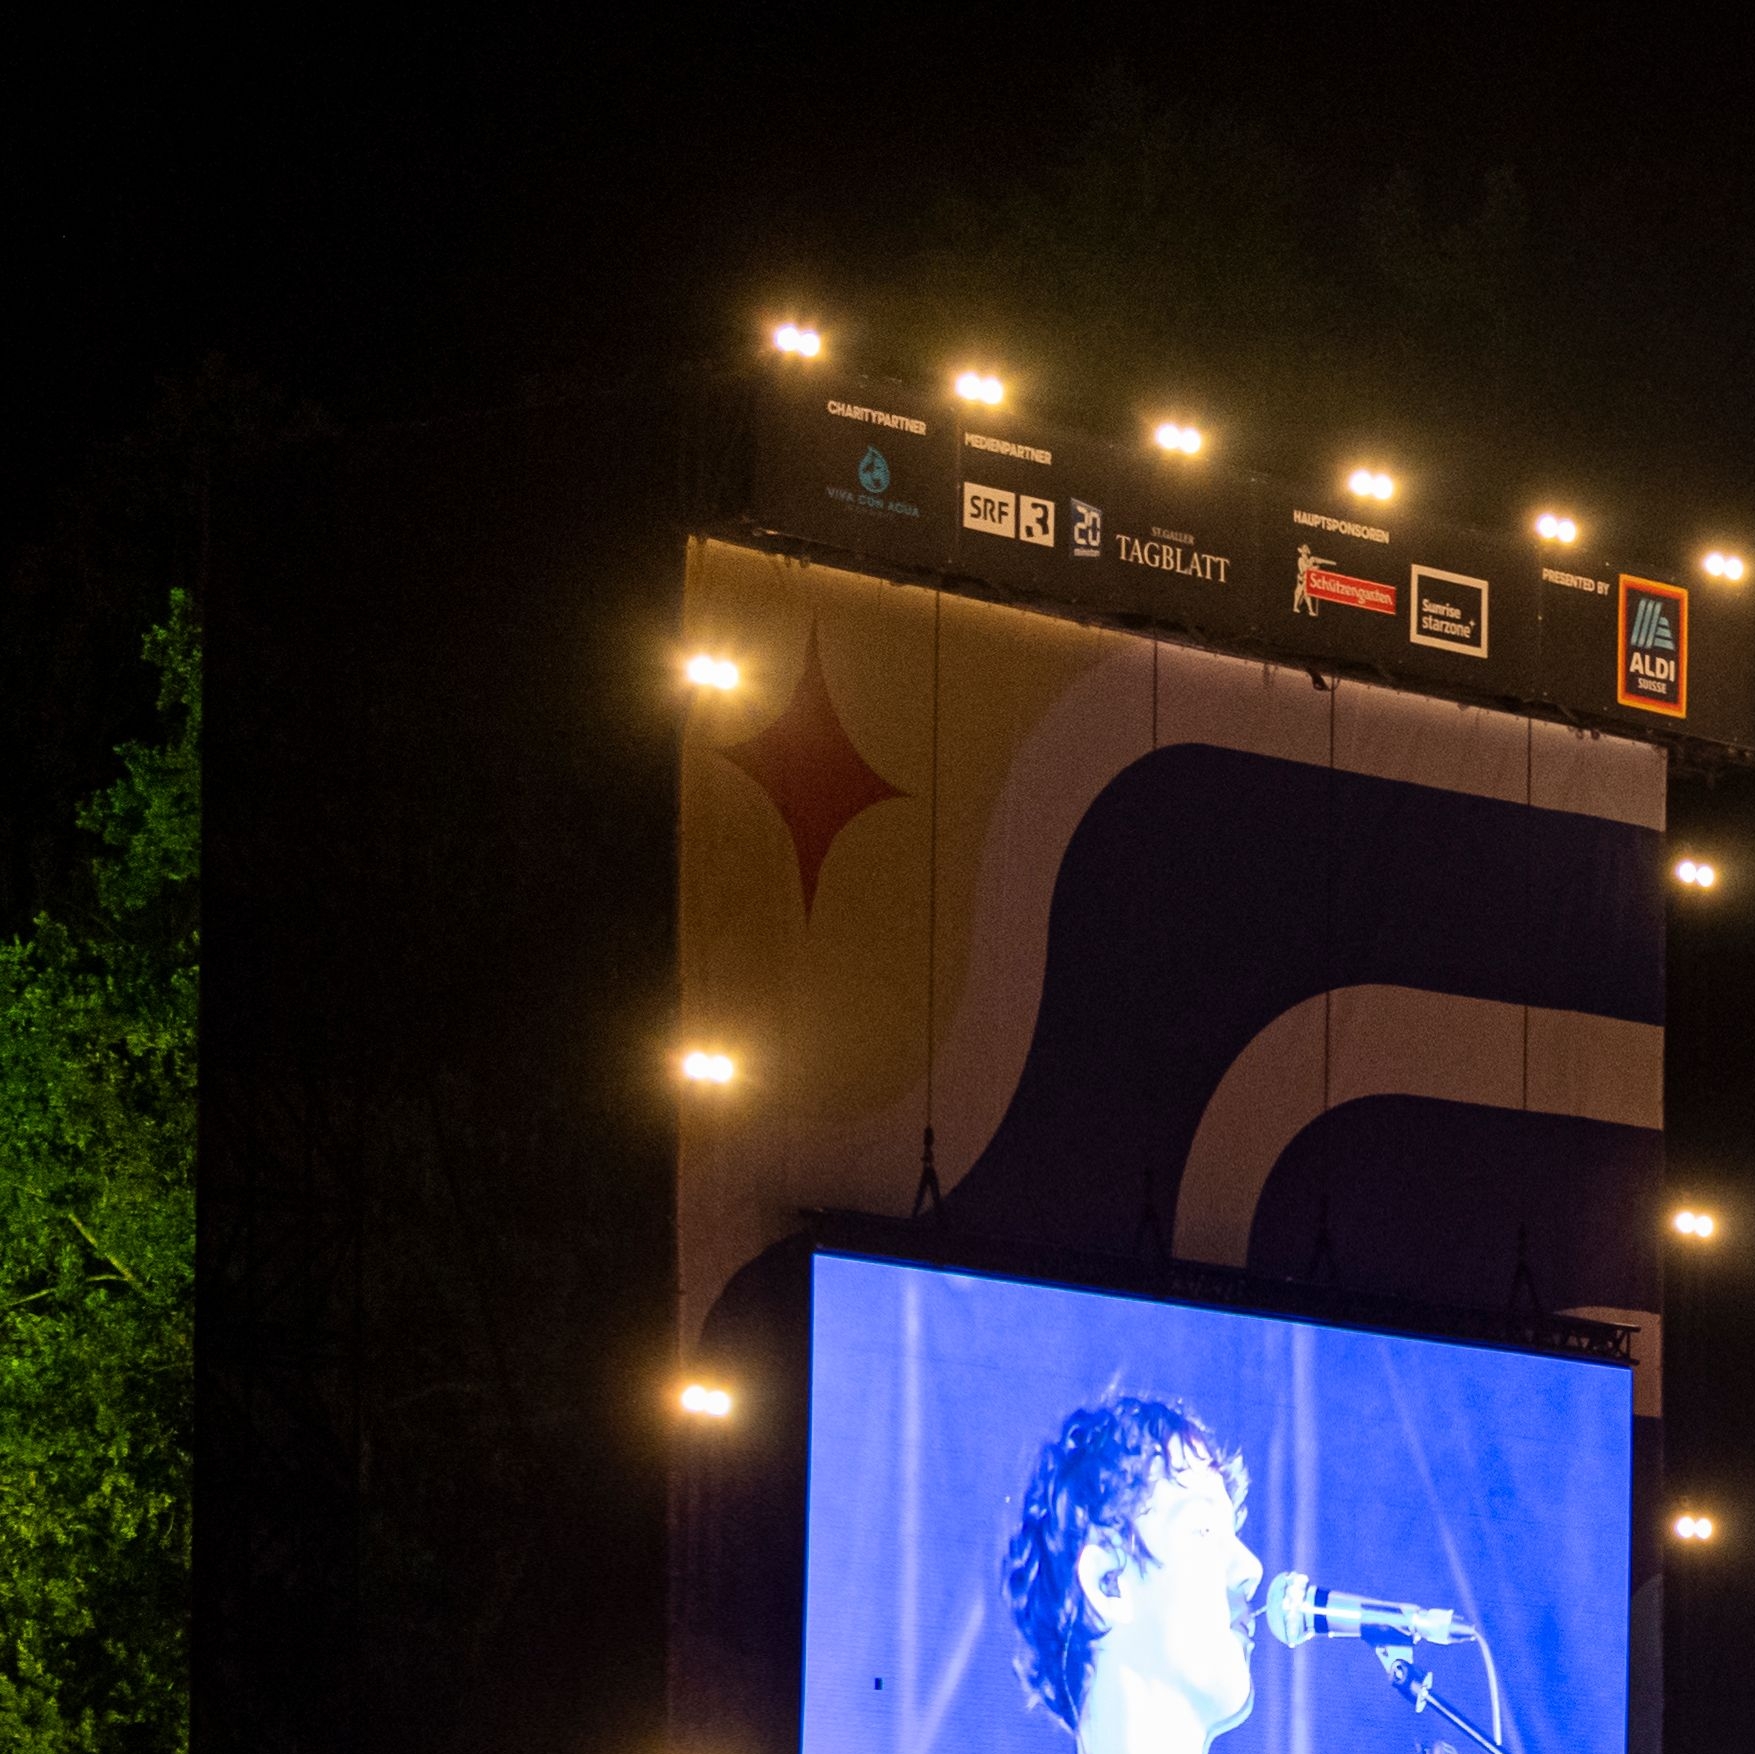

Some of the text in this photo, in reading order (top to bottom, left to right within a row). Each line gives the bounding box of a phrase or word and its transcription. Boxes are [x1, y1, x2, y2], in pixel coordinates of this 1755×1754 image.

[826, 399, 927, 436] CHARITYPARTNER
[964, 432, 1053, 466] MEDIENPARTNER
[969, 495, 1049, 538] SRF 3
[1073, 505, 1101, 547] 20
[1293, 510, 1390, 544] HAUPTSPONSOREN
[1115, 534, 1231, 583] TAGBLATT
[1309, 573, 1394, 606] Schützengarten
[1542, 567, 1611, 596] PRESENTED BY
[1422, 598, 1462, 620] Sunrise
[1422, 615, 1472, 639] starzone
[1629, 651, 1676, 683] ALDI
[1638, 677, 1667, 694] SUISSE
